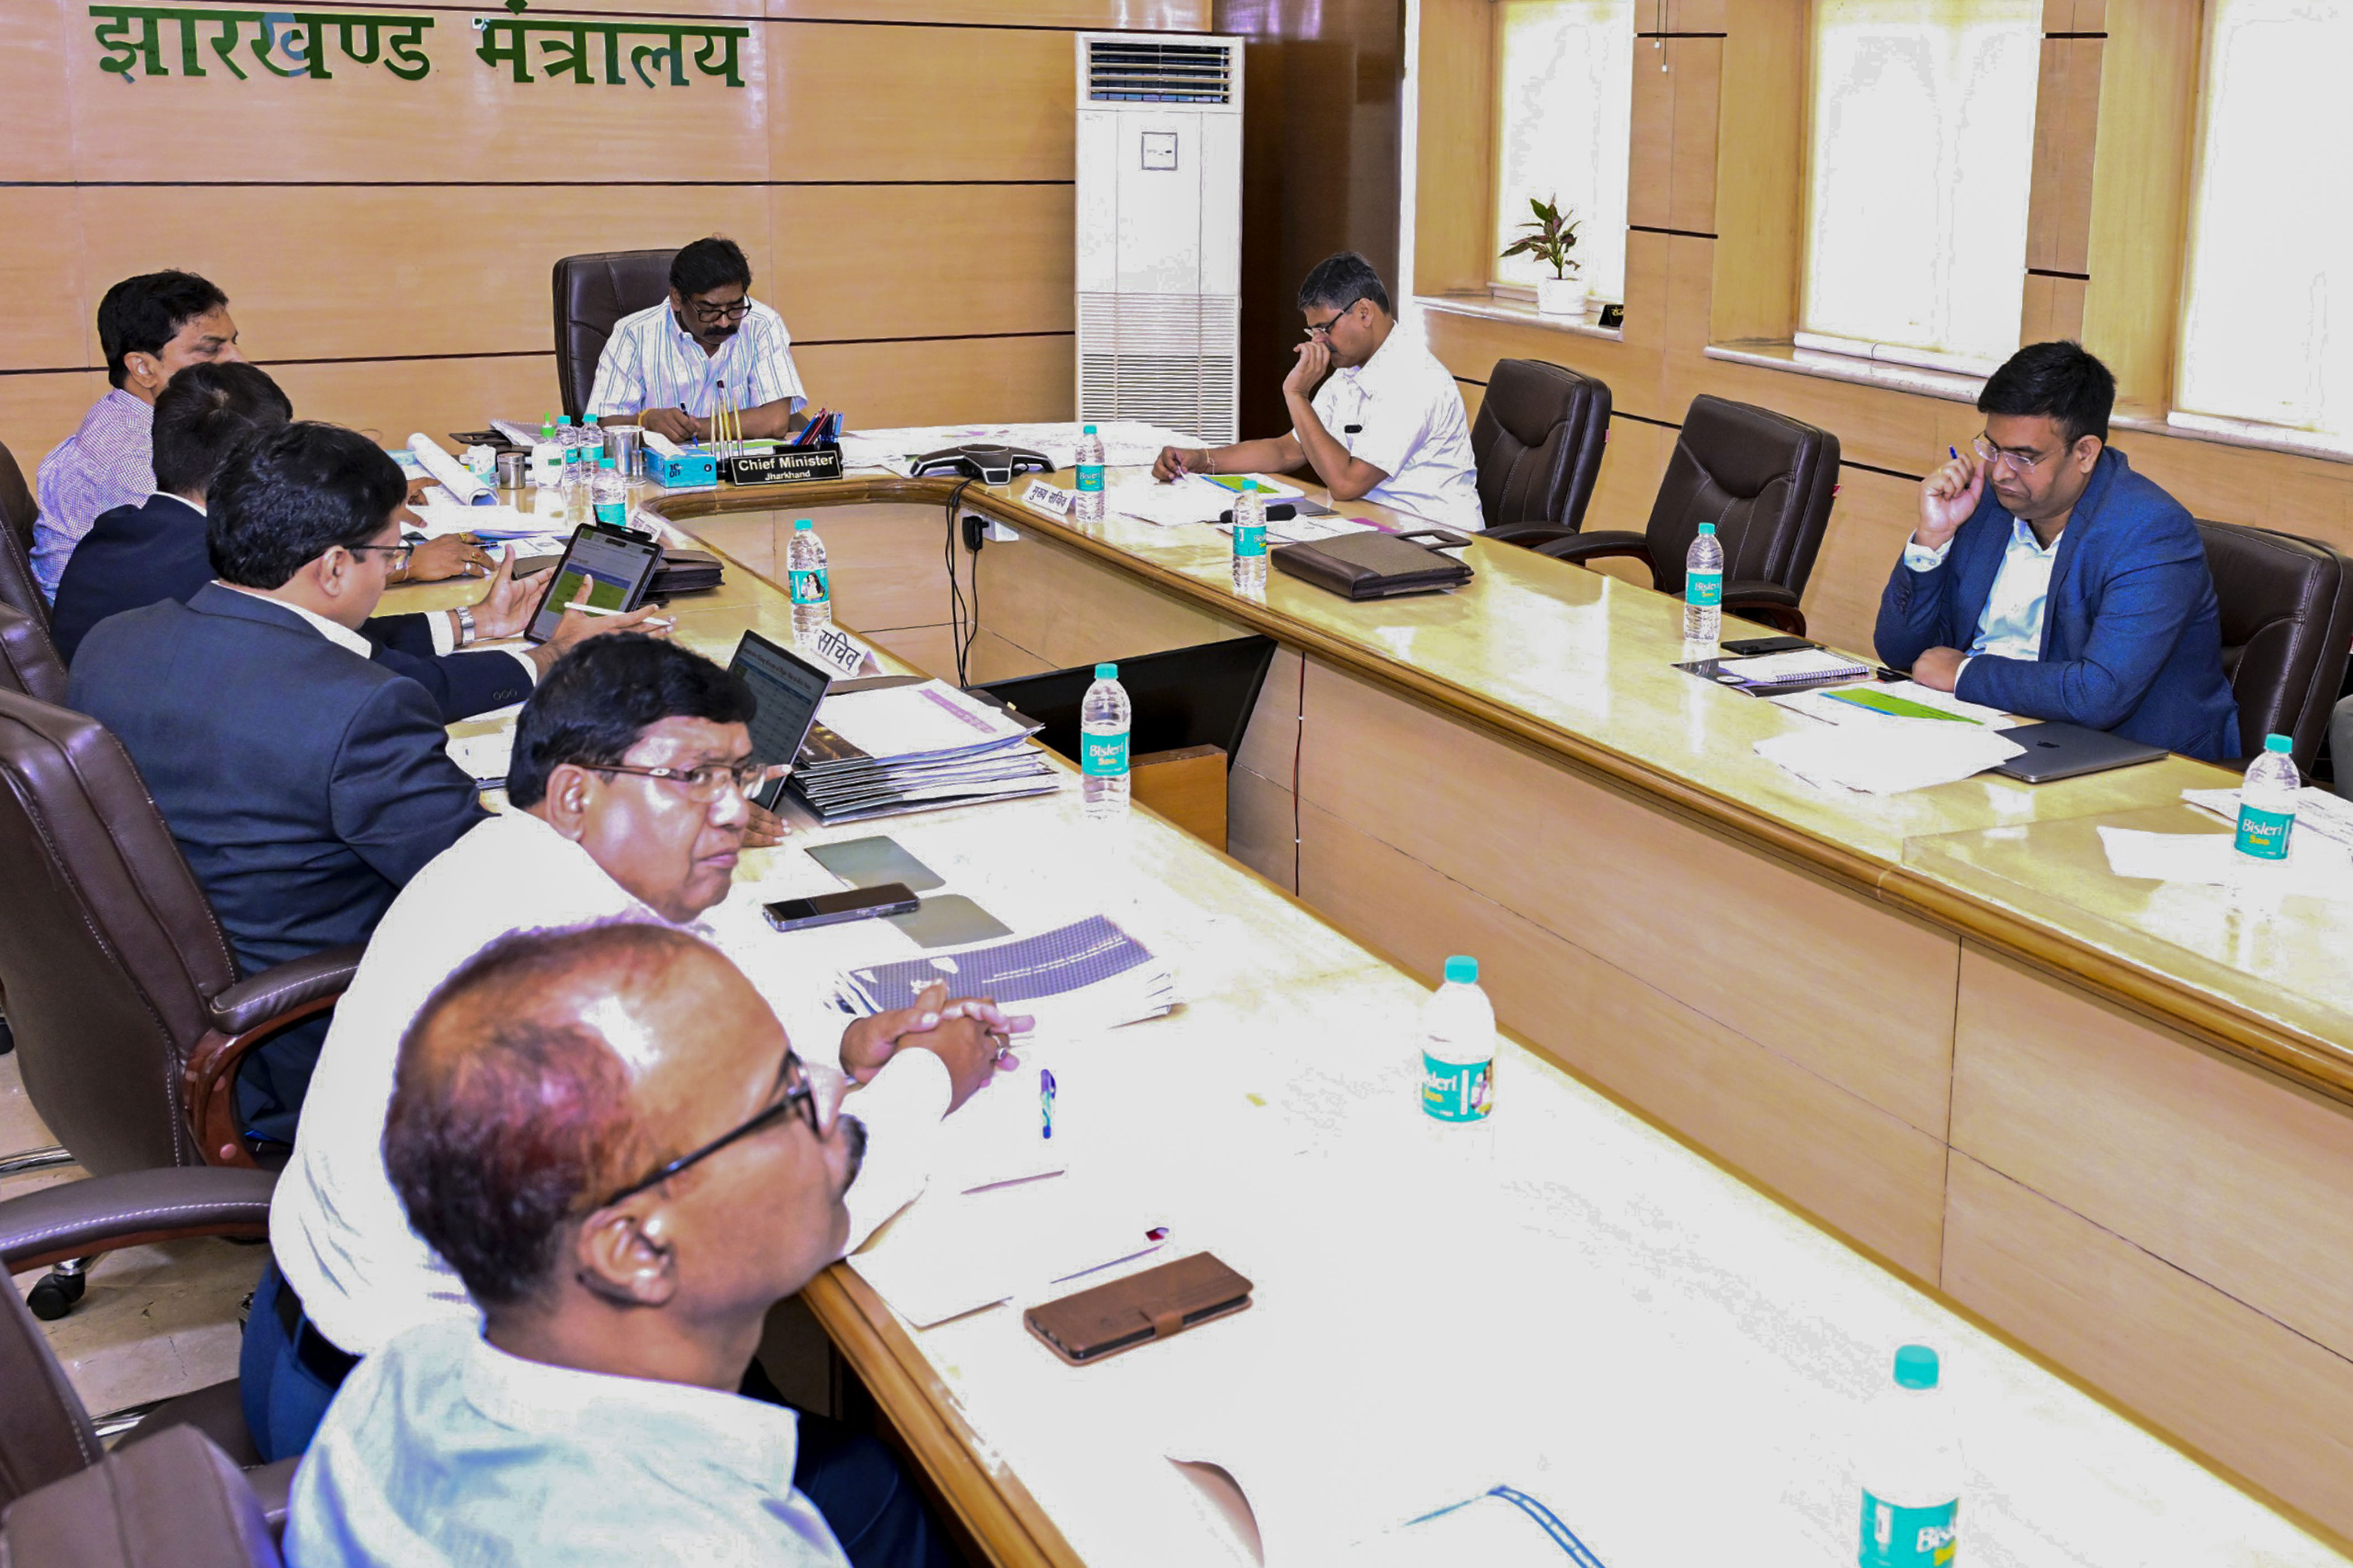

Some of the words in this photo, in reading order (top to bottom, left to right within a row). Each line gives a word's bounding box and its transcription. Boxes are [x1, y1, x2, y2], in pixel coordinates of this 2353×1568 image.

[89, 5, 435, 83] झारखण्ड
[471, 0, 749, 89] मंत्रालय
[738, 457, 775, 471] Chief
[779, 455, 834, 469] Minister
[765, 470, 811, 480] Jharkhand
[1048, 490, 1068, 507] सचिव
[818, 629, 861, 671] सचिव
[1090, 742, 1124, 757] Bisleri
[2242, 819, 2283, 837] Bisleri
